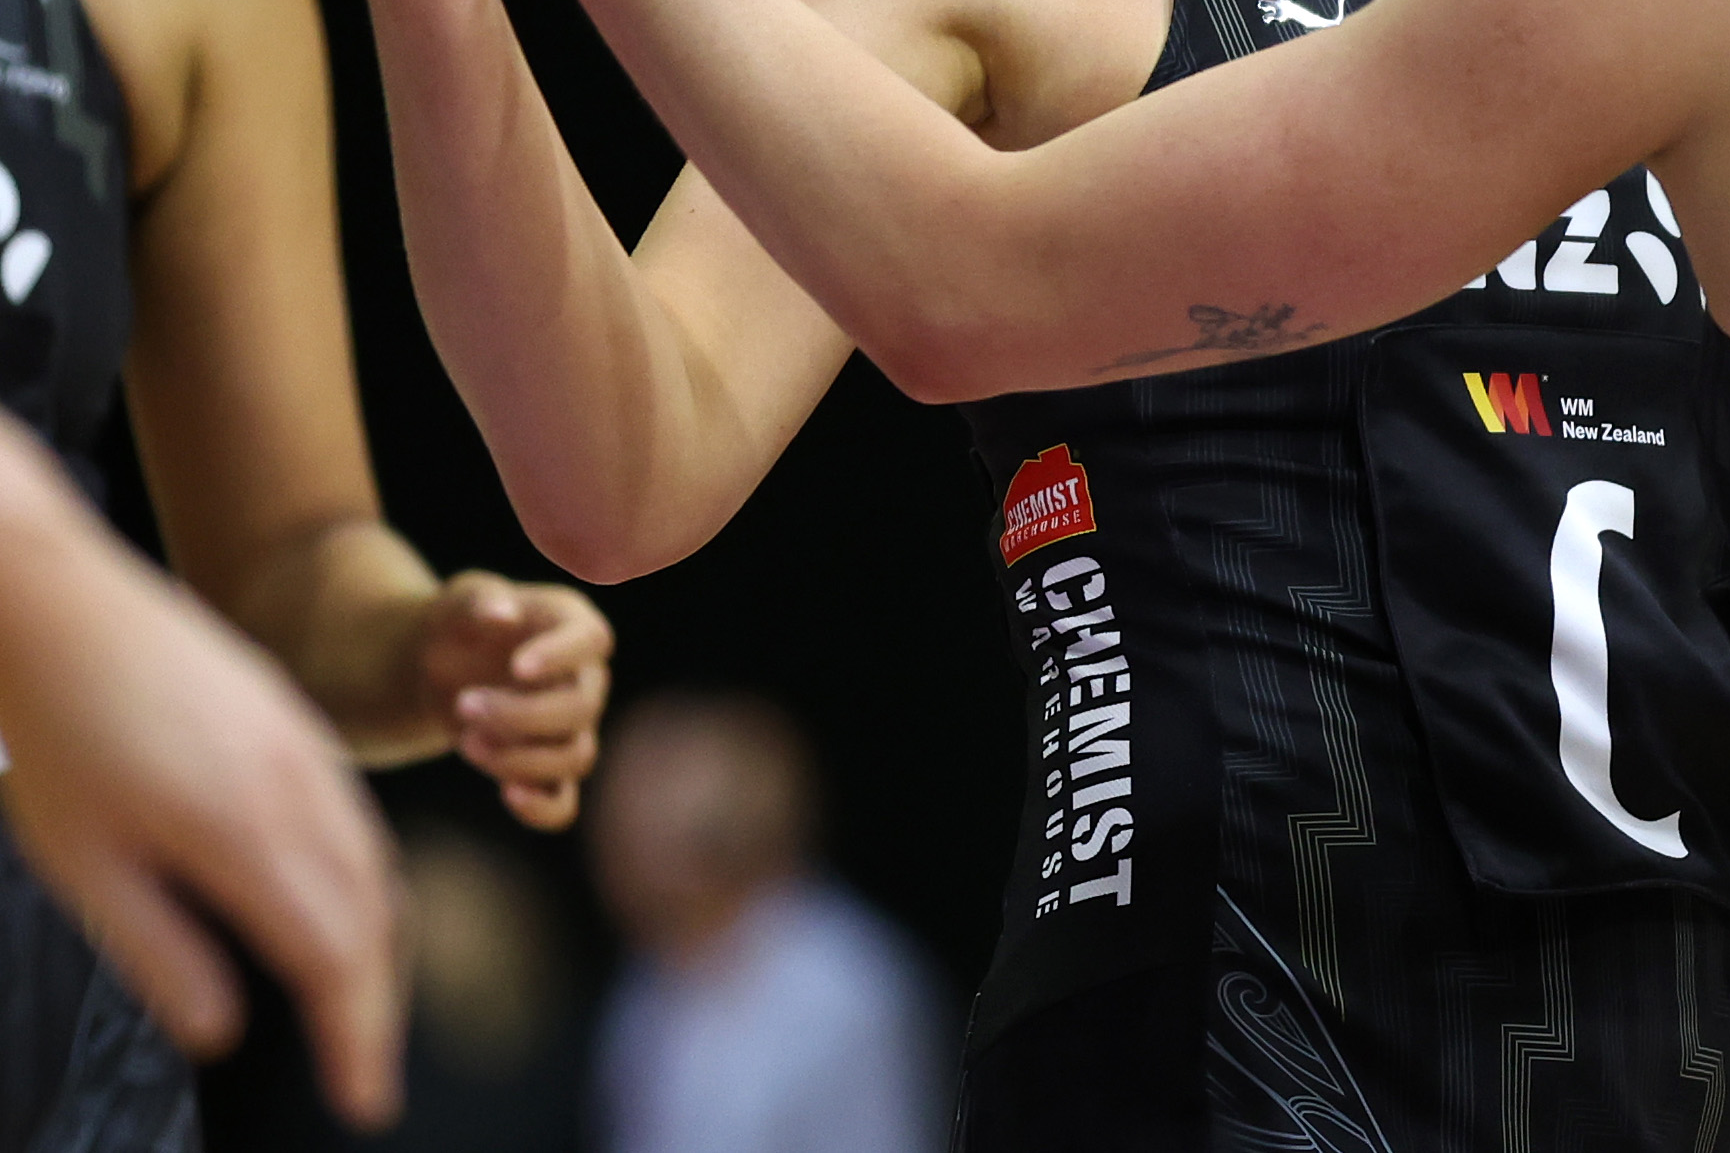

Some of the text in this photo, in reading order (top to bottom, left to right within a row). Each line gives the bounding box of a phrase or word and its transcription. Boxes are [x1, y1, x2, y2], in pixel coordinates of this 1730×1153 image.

[1560, 397, 1594, 417] WM
[1562, 420, 1665, 446] New Zealand
[1007, 477, 1079, 536] CHEMIST
[1015, 577, 1064, 920] WAREHOUSE
[1041, 556, 1134, 907] CHEMIST
